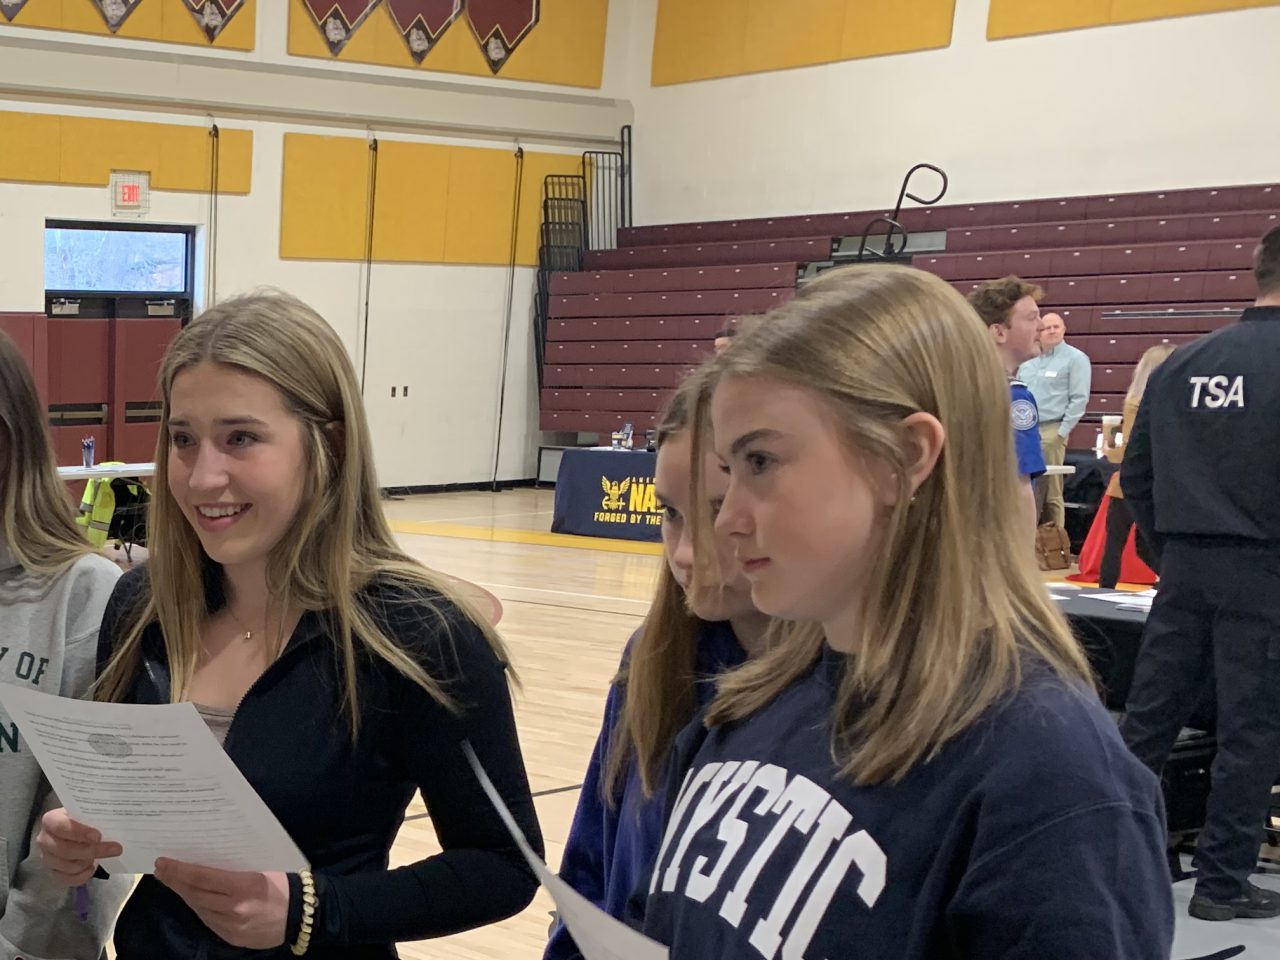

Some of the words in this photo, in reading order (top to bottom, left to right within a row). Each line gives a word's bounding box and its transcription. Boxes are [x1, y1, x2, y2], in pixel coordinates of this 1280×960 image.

[121, 184, 140, 203] EXIT
[1189, 375, 1245, 408] TSA
[594, 512, 627, 523] FORGED
[629, 514, 642, 524] BY
[645, 515, 662, 526] THE
[15, 651, 50, 686] OF
